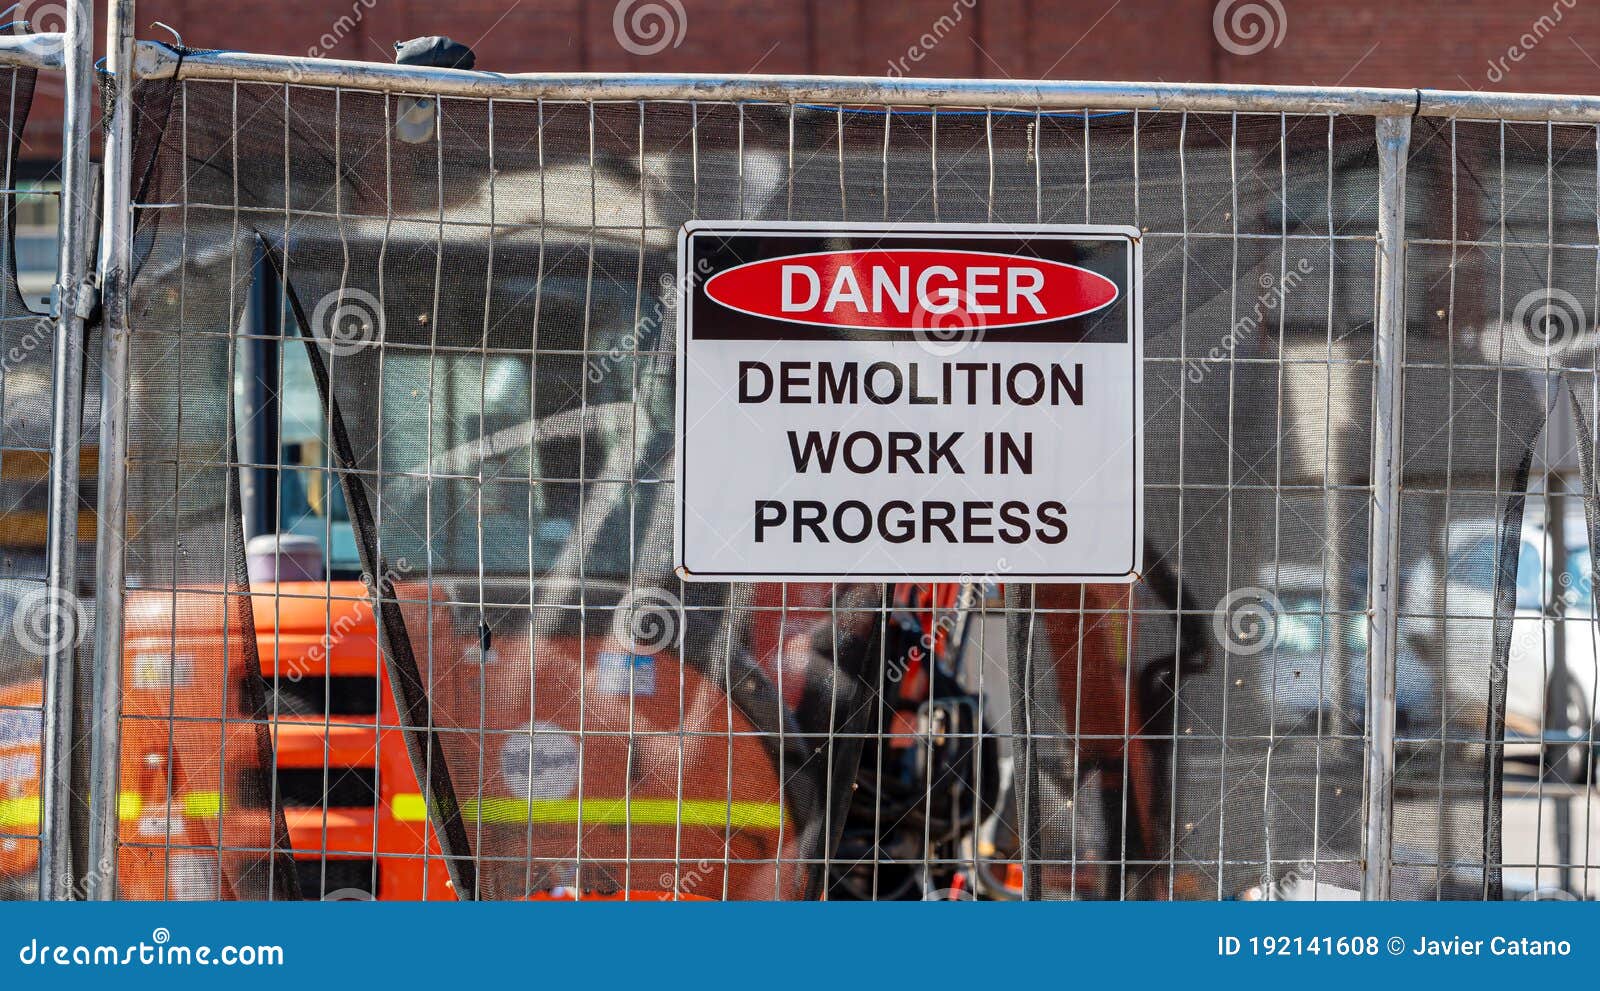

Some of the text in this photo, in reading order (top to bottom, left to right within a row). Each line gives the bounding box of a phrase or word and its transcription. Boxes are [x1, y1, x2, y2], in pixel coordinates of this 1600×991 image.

[781, 265, 1047, 315] DANGER
[738, 361, 1084, 406] DEMOLITION
[787, 431, 1033, 474] WORK IN
[754, 500, 1068, 544] PROGRESS
